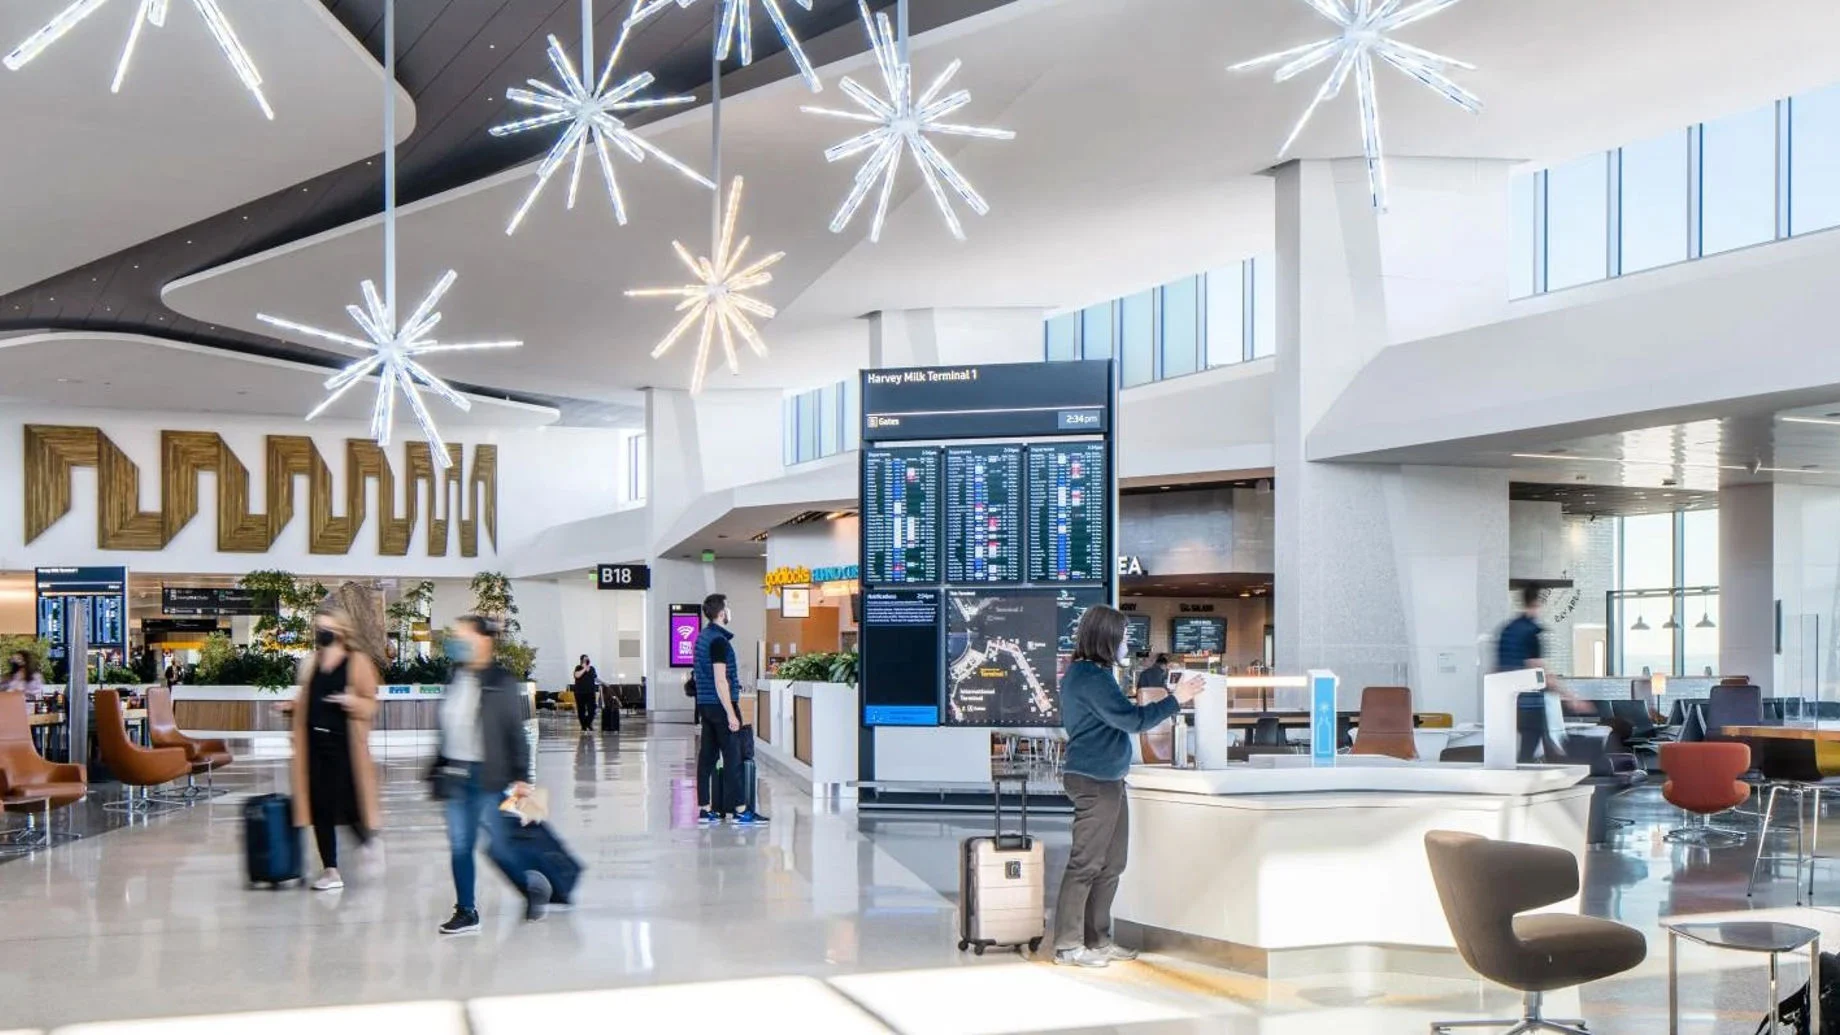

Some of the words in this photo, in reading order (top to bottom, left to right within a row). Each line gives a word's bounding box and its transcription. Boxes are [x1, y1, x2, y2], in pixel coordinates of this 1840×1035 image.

[867, 373, 902, 385] Harvey
[904, 371, 926, 383] Milk
[927, 369, 970, 382] Terminal
[971, 369, 977, 380] 1
[879, 418, 900, 426] Gates
[1066, 414, 1098, 424] 2:34pm
[602, 568, 632, 583] B18
